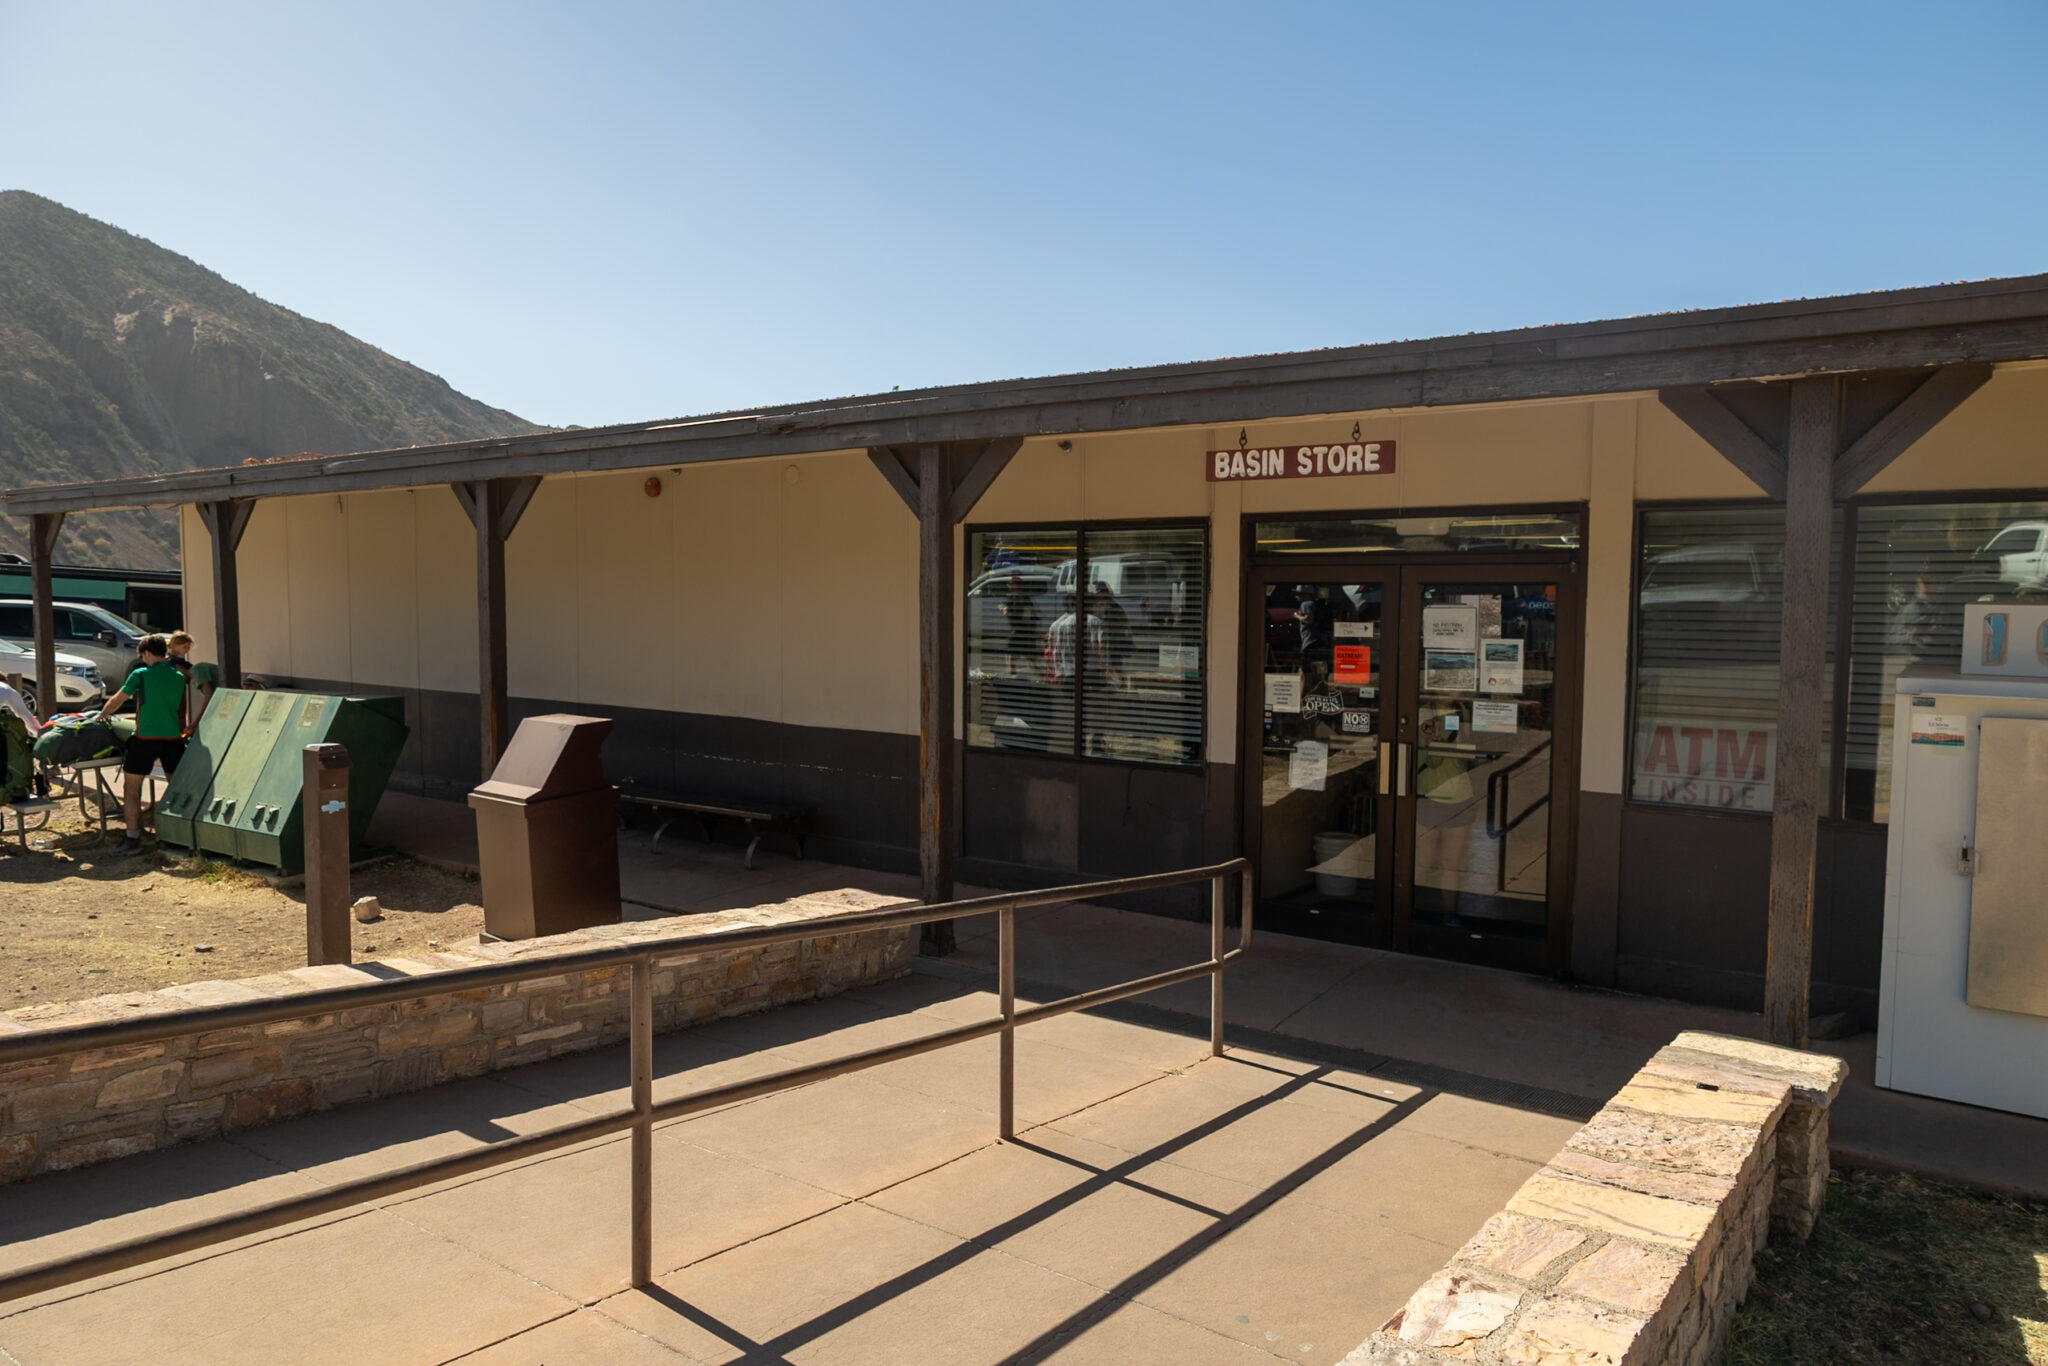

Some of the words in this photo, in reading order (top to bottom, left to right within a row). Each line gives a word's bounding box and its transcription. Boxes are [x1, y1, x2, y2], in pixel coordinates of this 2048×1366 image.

[1215, 449, 1284, 479] BASIN
[1297, 443, 1381, 475] STORE
[1981, 612, 2048, 668] I
[1305, 700, 1340, 712] OPEN
[1344, 713, 1359, 724] NO
[1643, 725, 1768, 781] ATM
[1647, 779, 1757, 809] INSIDE
